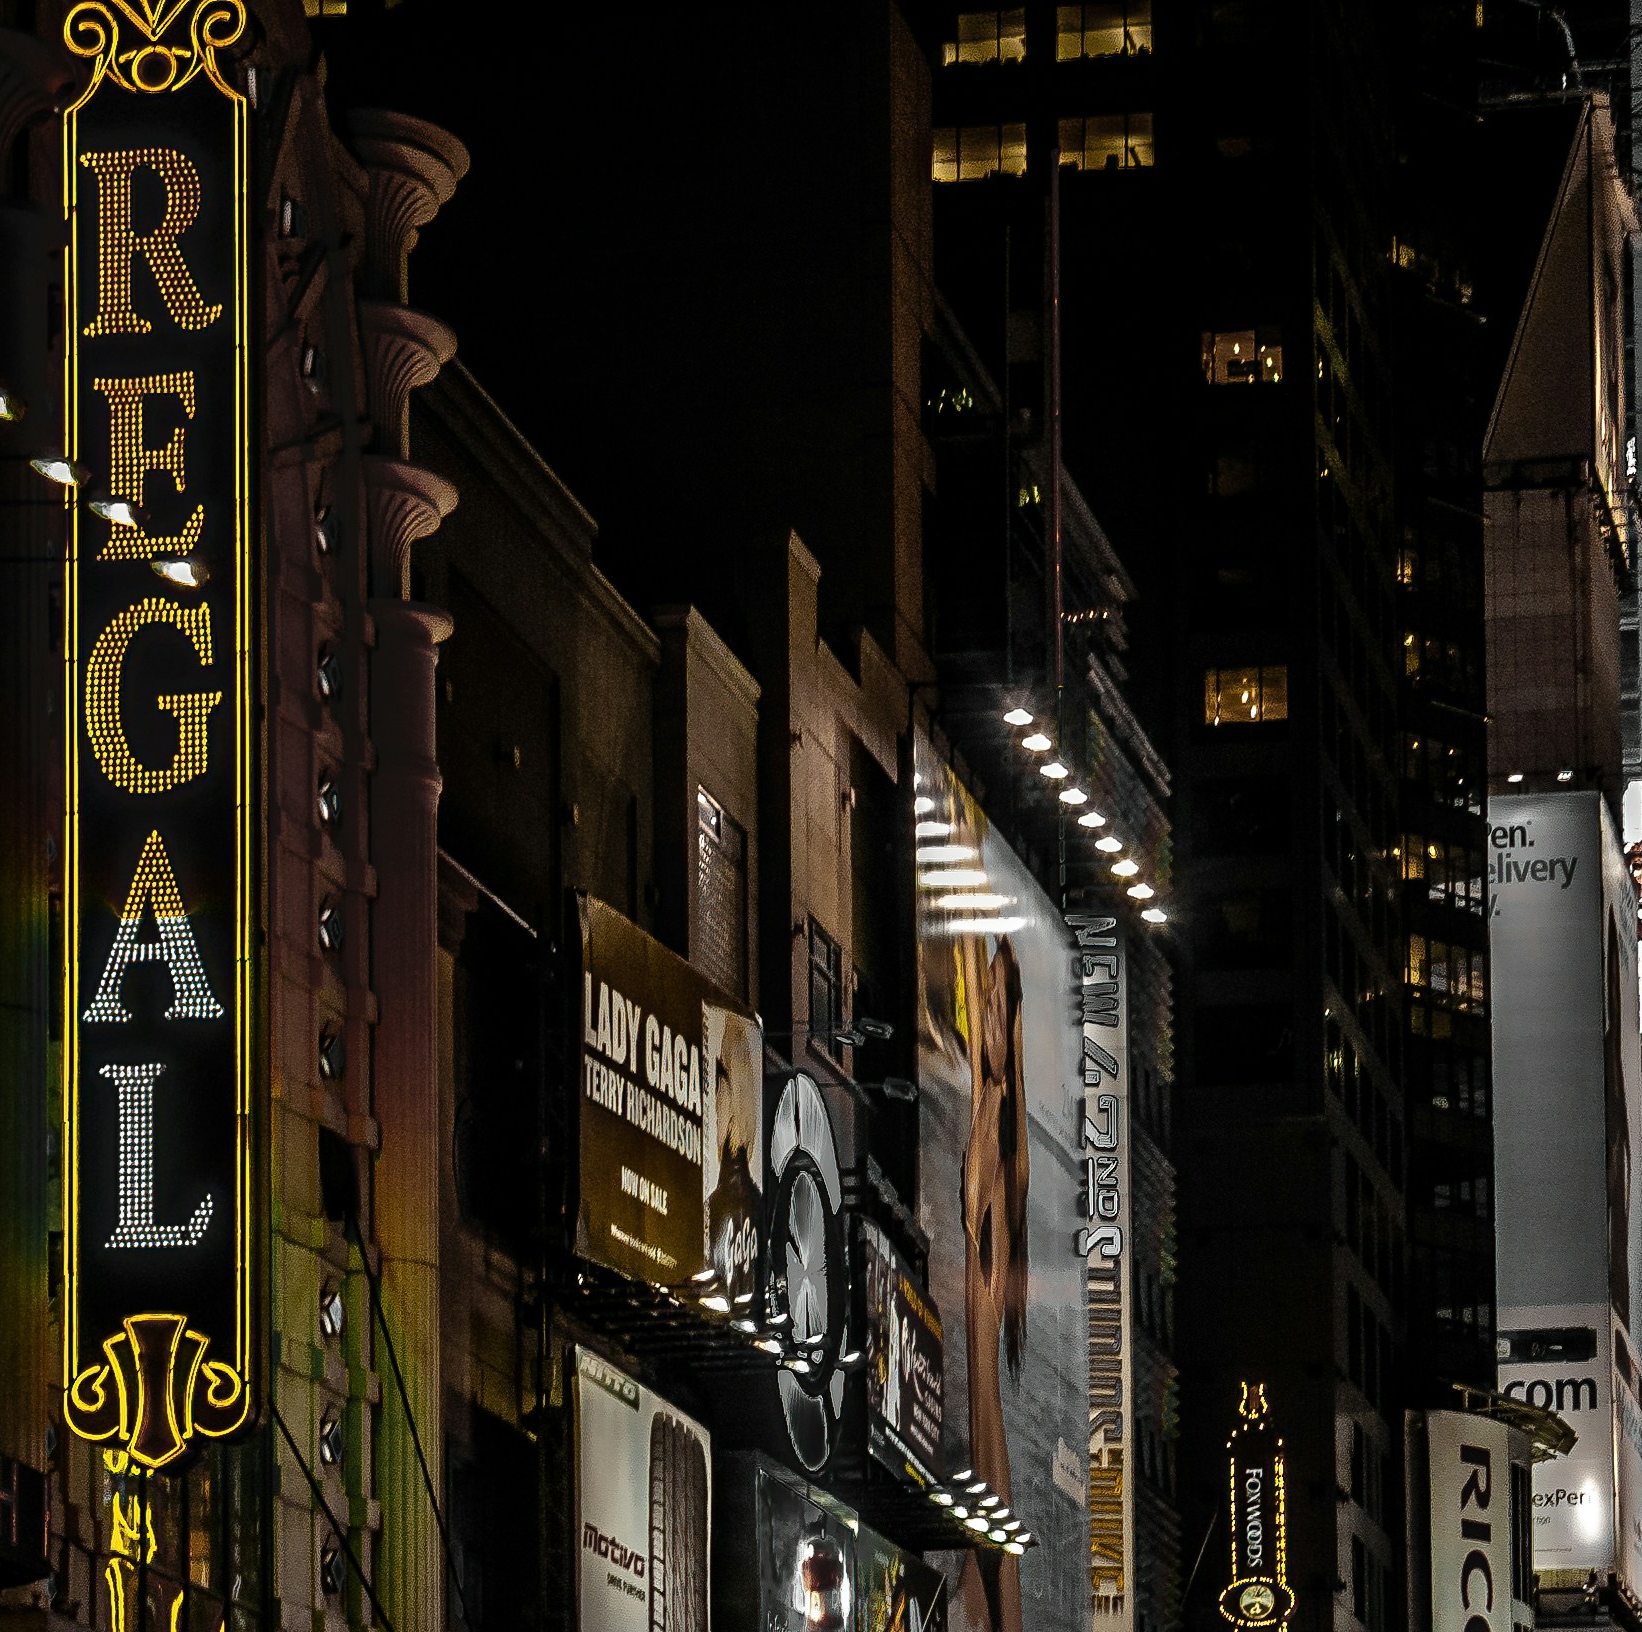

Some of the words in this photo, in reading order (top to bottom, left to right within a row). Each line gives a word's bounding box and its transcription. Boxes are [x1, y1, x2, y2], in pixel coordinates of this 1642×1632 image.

[79, 147, 225, 1249] REGAL
[584, 970, 641, 1075] LADY
[645, 1013, 703, 1117] GAGA
[584, 1053, 625, 1117] TERRY
[626, 1081, 702, 1167] RICHARDSON
[583, 1521, 646, 1579] motivo
[1245, 1467, 1263, 1569] FOXWOODS
